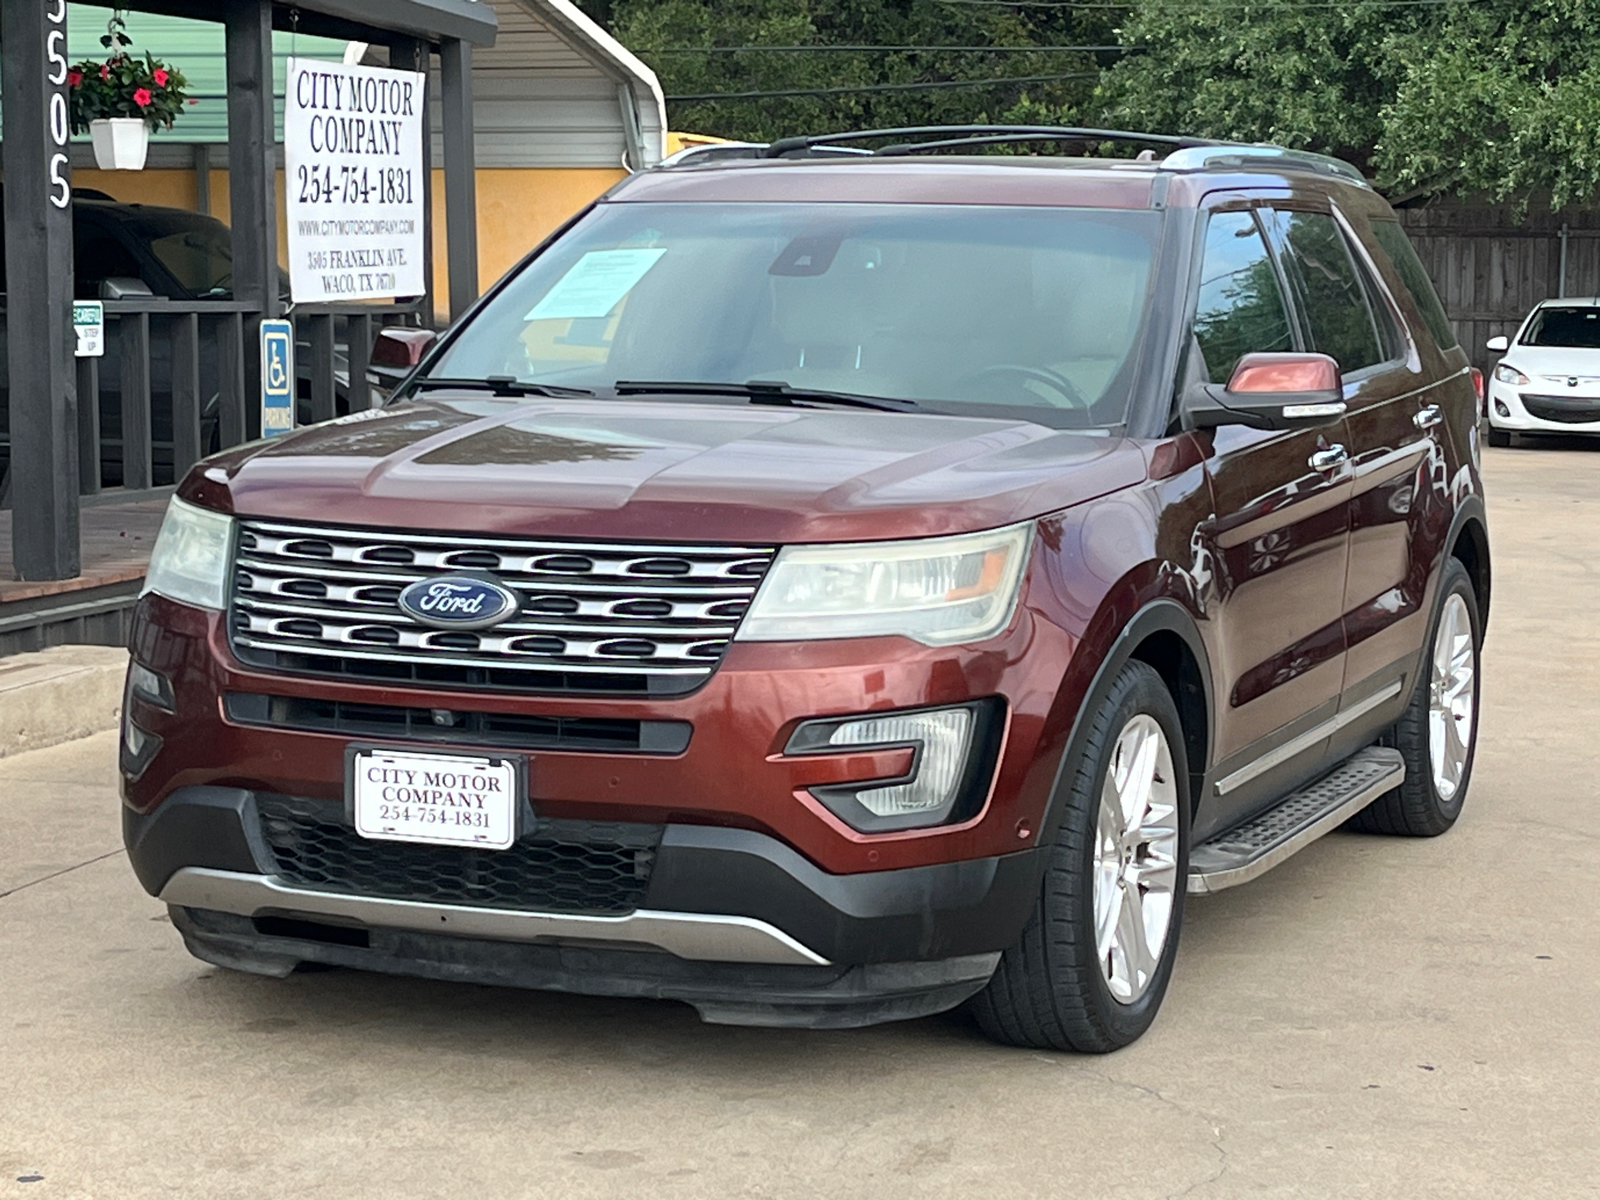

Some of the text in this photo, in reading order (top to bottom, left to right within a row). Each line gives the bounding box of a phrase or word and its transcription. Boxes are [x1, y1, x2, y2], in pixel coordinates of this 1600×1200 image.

[297, 70, 413, 116] CITY MOTOR
[310, 114, 402, 155] COMPANY
[298, 163, 413, 204] 254-754-1831
[298, 219, 415, 237] WWW.CITYMOTORCOMPANY.COM
[307, 250, 328, 270] 3505
[329, 248, 385, 269] FRANKLIN
[358, 272, 374, 292] TX
[420, 583, 486, 614] Ford
[367, 767, 502, 792] CITY MOTOR
[382, 786, 488, 809] COMPANY
[379, 804, 490, 828] 254-754-1831
